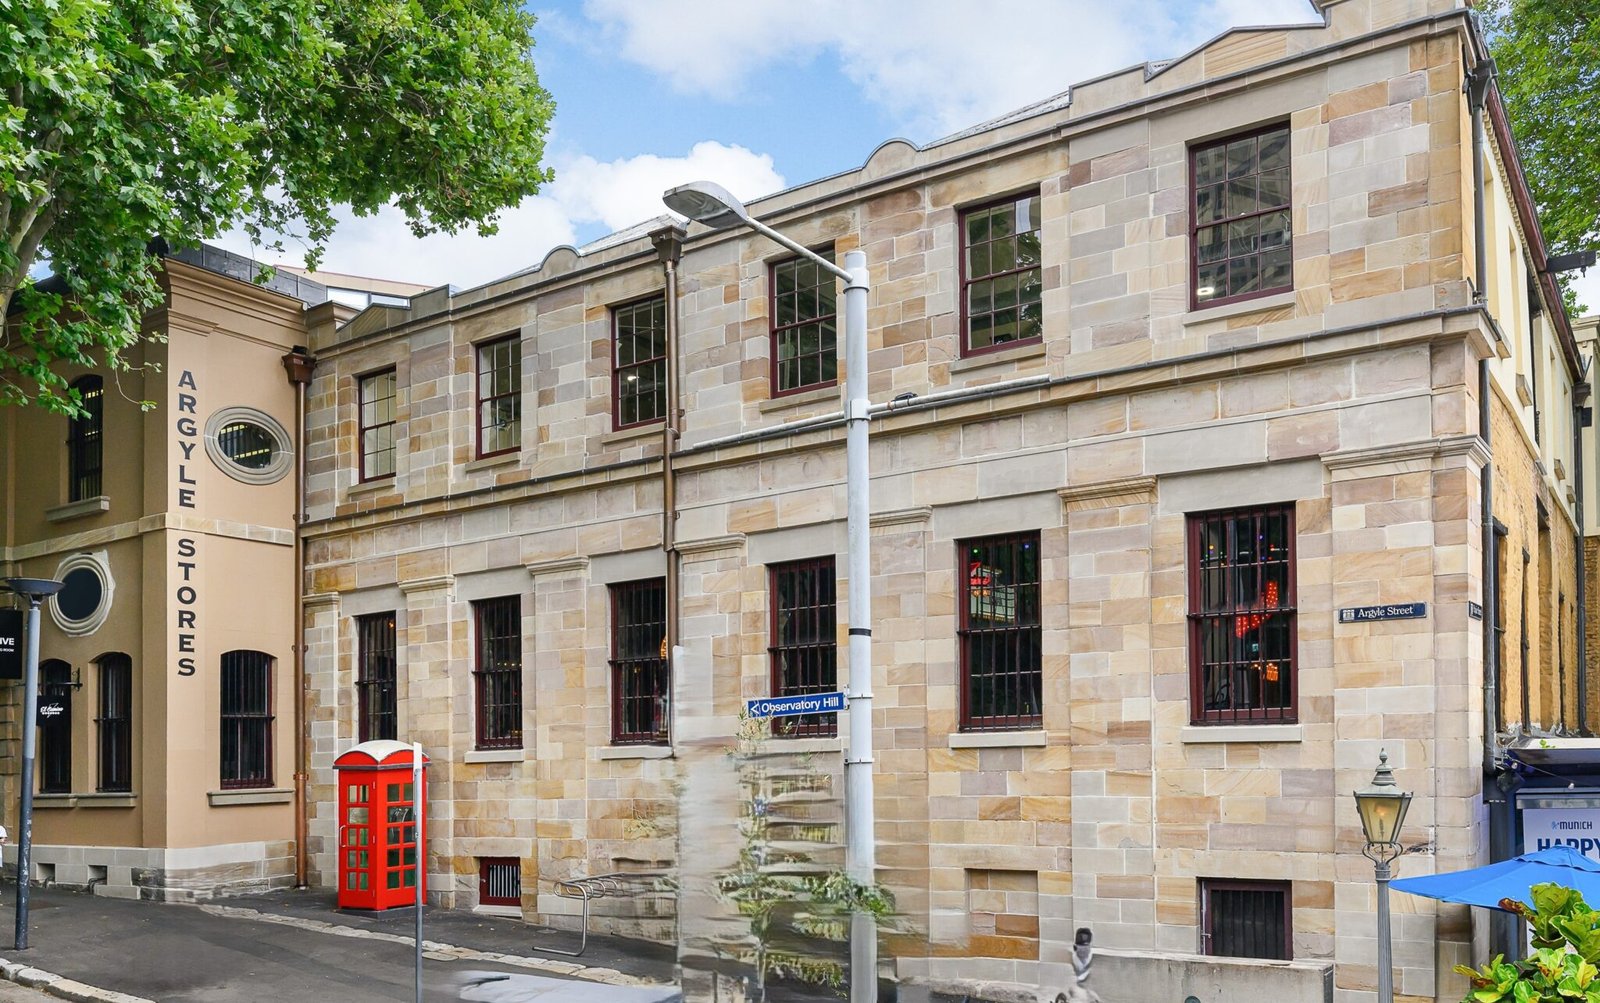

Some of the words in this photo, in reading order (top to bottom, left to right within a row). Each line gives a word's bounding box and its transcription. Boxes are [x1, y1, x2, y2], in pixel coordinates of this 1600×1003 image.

[177, 370, 197, 508] ARGYLE
[177, 538, 197, 677] STORES
[1357, 607, 1385, 619] Argyle
[1387, 605, 1414, 615] Street
[761, 701, 821, 713] Observatory
[823, 697, 839, 708] Hill
